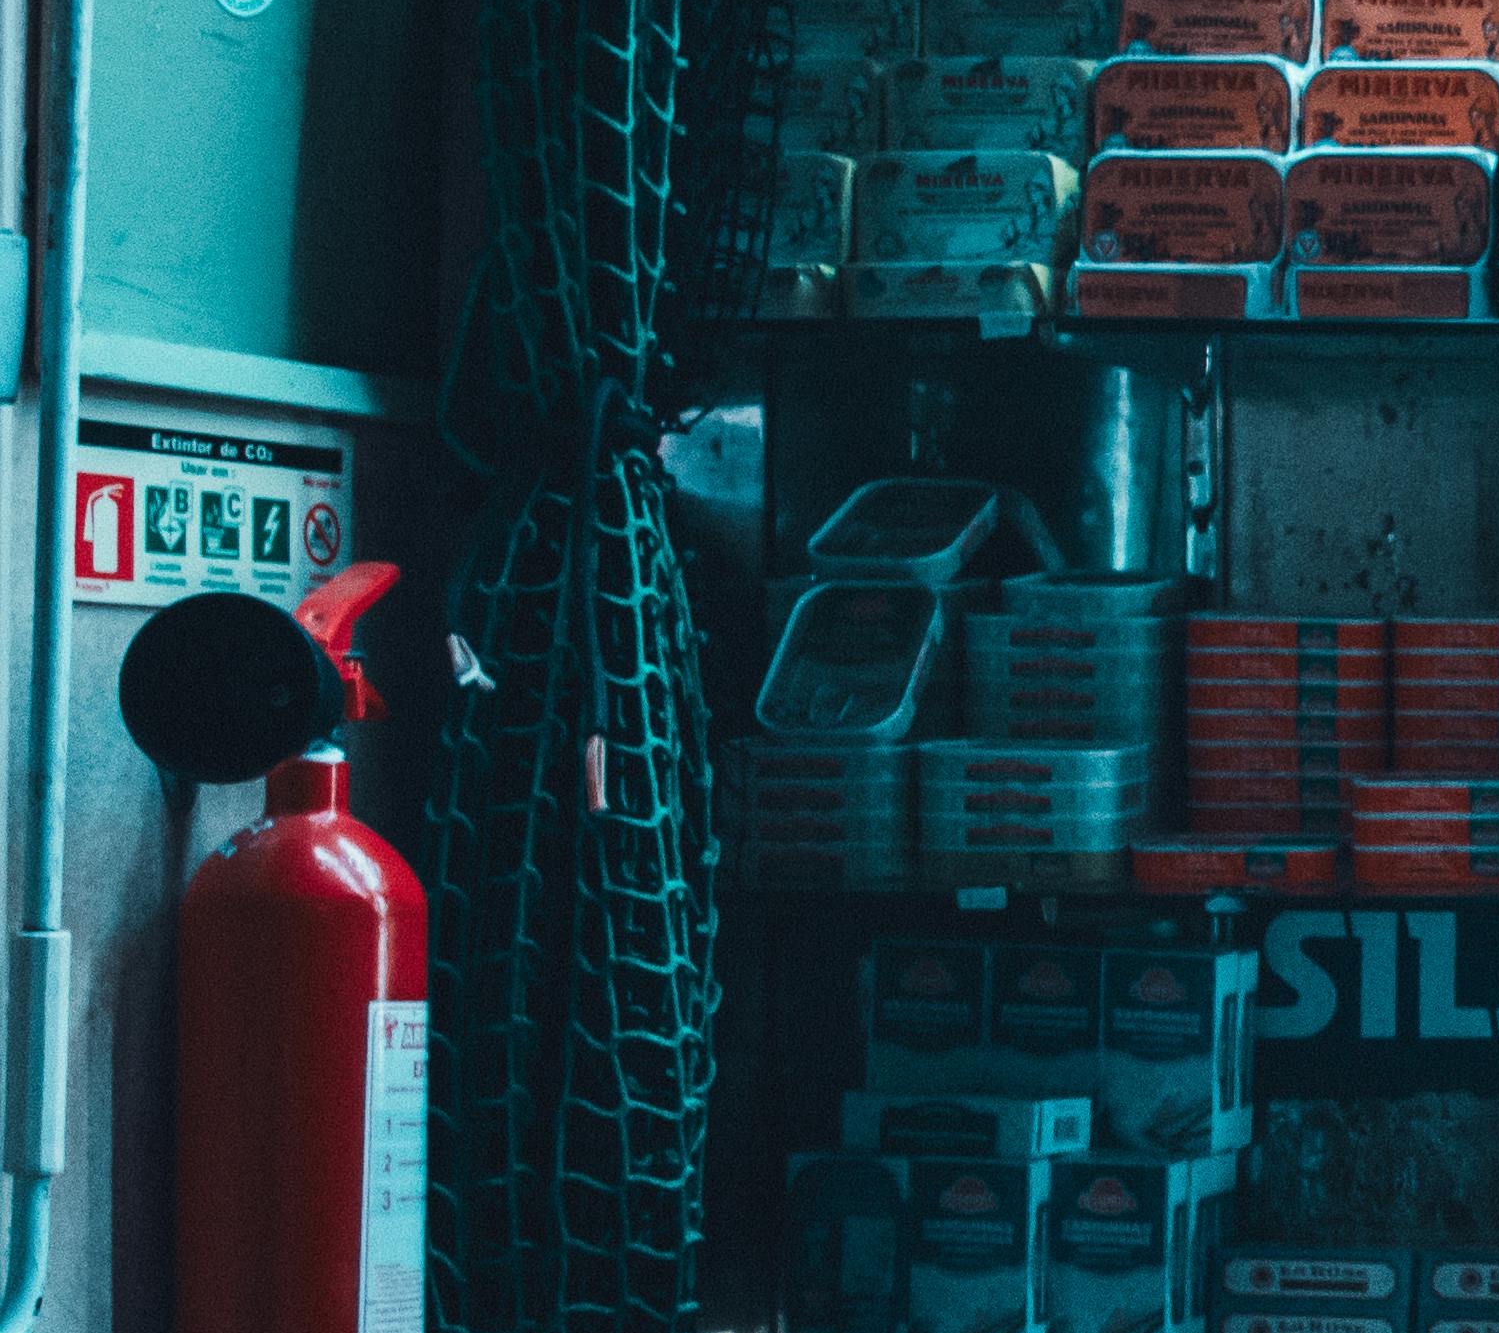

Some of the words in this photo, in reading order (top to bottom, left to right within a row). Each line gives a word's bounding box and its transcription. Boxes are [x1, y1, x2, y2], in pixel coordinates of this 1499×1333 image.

[1127, 70, 1258, 93] MINERVA
[1336, 75, 1471, 99] MINERVA
[151, 432, 213, 456] Extintor
[174, 490, 190, 515] B
[226, 493, 242, 518] C
